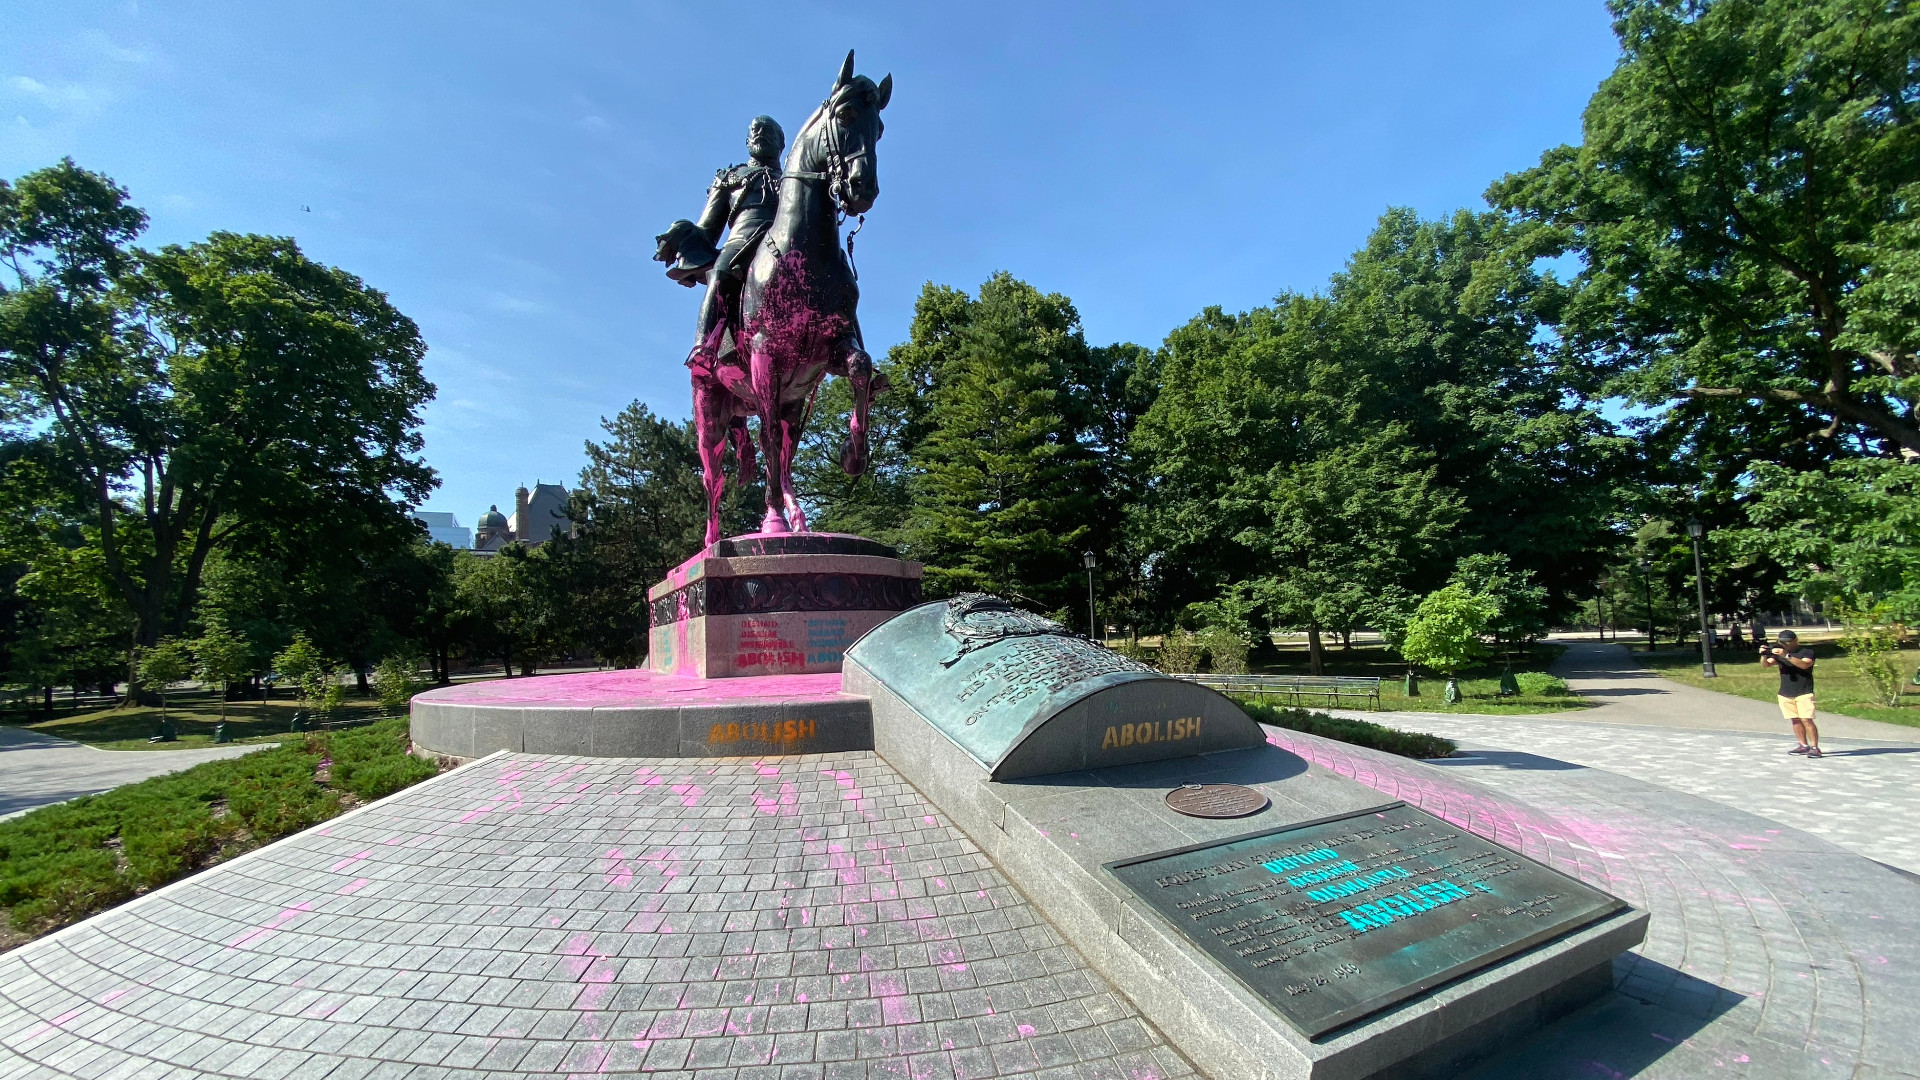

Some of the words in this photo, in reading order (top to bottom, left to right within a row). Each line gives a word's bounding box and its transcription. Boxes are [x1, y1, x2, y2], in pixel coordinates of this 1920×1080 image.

[958, 680, 985, 703] HIS
[708, 719, 816, 745] ABOLISH
[1102, 717, 1201, 750] ABOLISH
[1153, 860, 1250, 887] EQUESTRIAN
[1247, 847, 1302, 865] STATUE
[1297, 843, 1322, 852] OF
[1318, 835, 1357, 848] KING
[1262, 848, 1339, 875] DEFUND
[1286, 860, 1361, 888] DISARM
[1307, 866, 1411, 903] DISMANTLE
[1175, 894, 1227, 909] Originally
[1340, 879, 1473, 932] ABOLISH
[1250, 951, 1289, 967] through
[1288, 947, 1308, 956] the
[1307, 933, 1345, 952] personal
[1282, 983, 1315, 995] May
[1327, 962, 1365, 981] 1969
